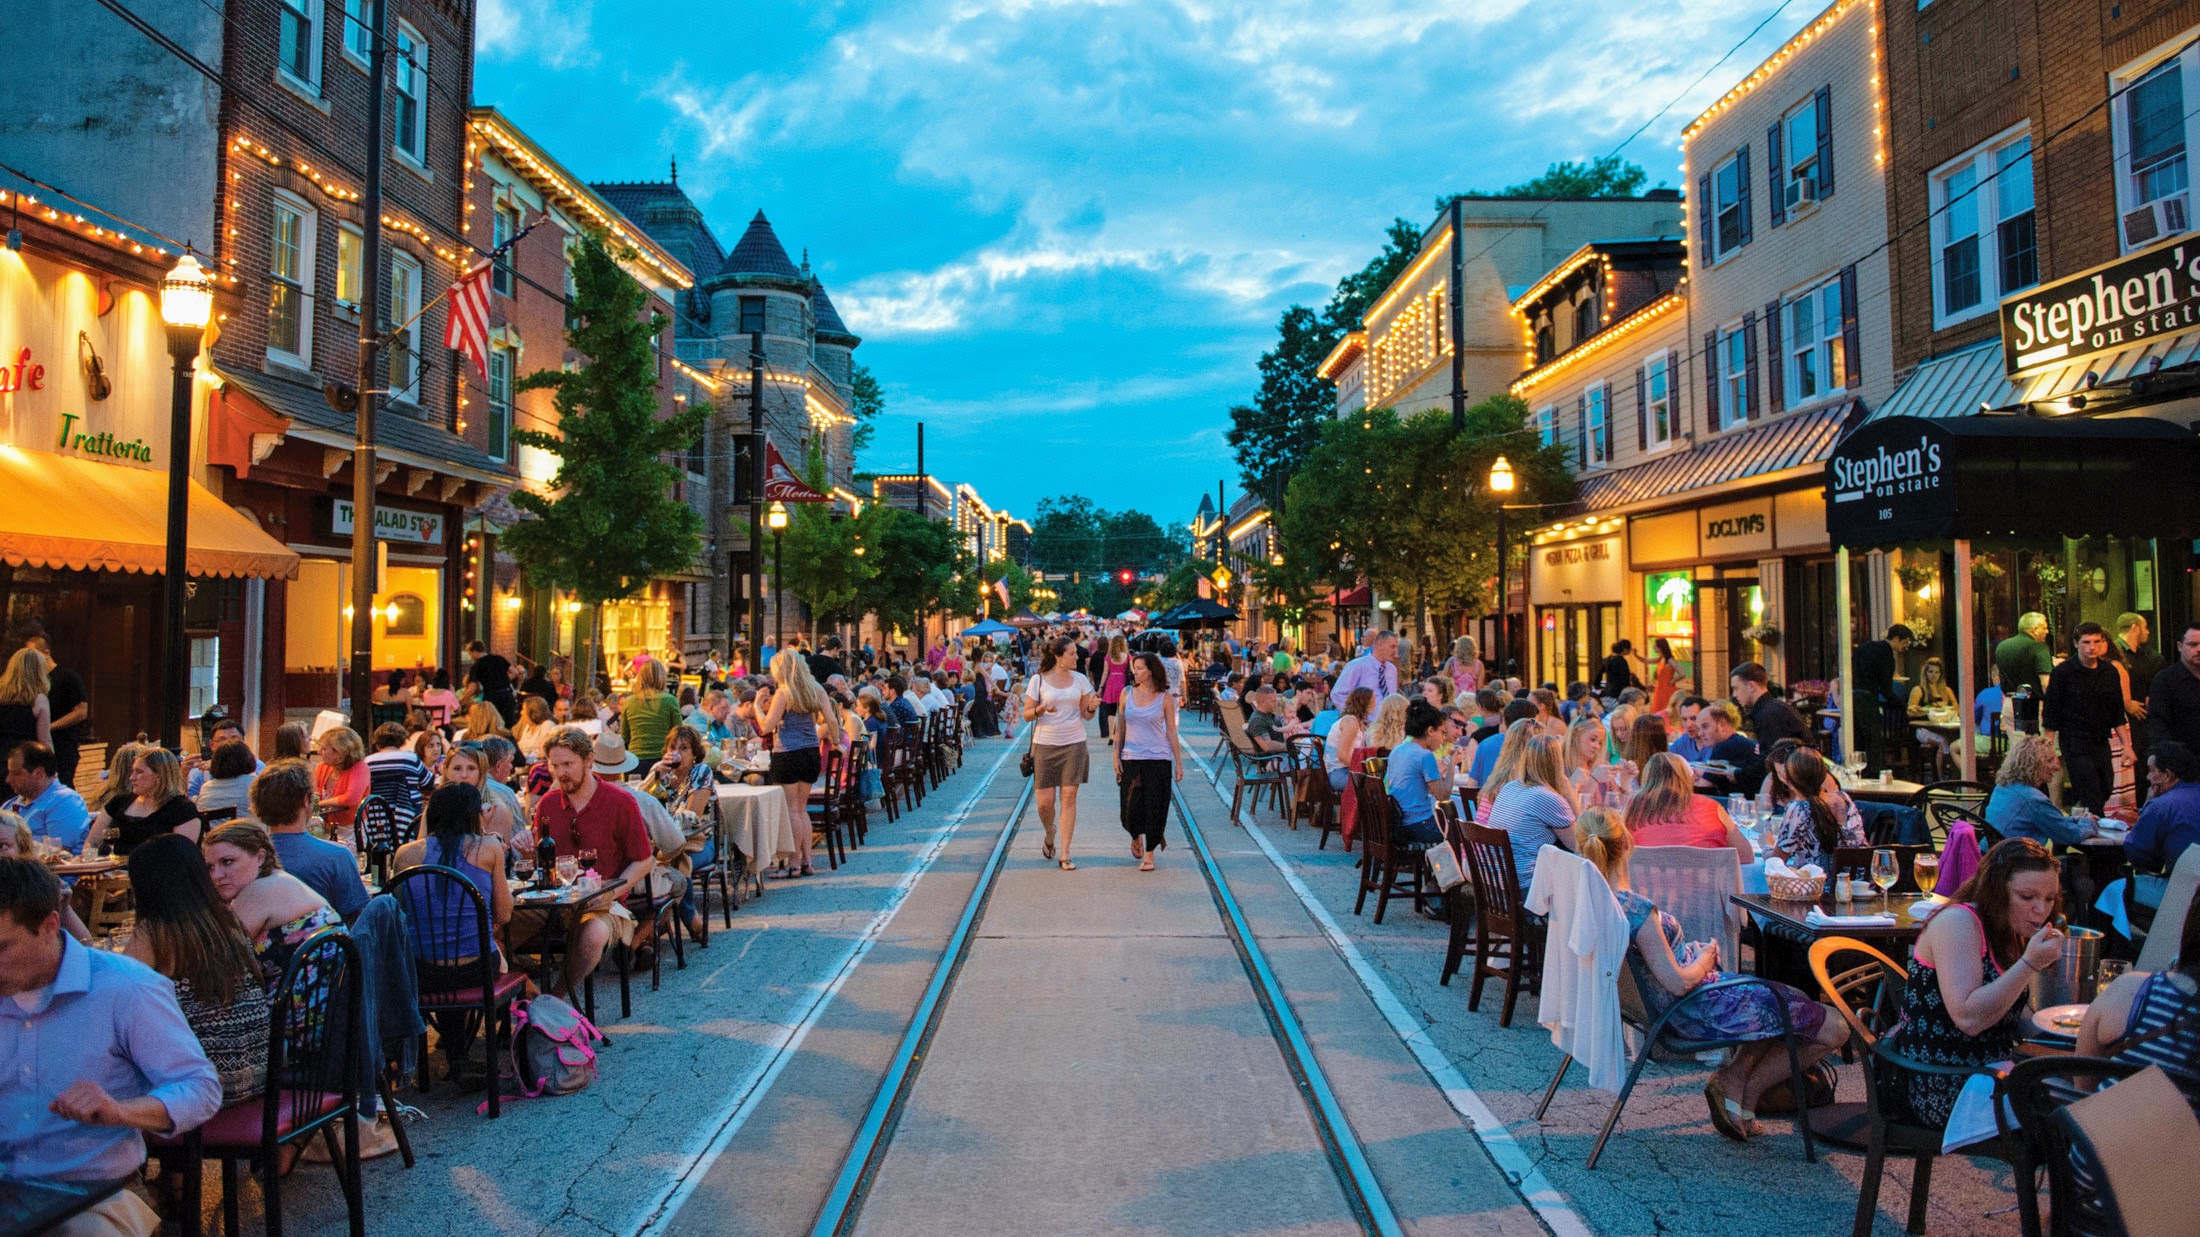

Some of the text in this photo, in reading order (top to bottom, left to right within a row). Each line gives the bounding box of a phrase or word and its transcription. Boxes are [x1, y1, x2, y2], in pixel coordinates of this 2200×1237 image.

[2092, 304, 2200, 348] on stat
[60, 412, 152, 463] Trattoria
[1833, 435, 1942, 494] Stephen's
[1876, 475, 1940, 498] on state
[374, 509, 408, 530] ALAD
[1879, 507, 1893, 520] 105
